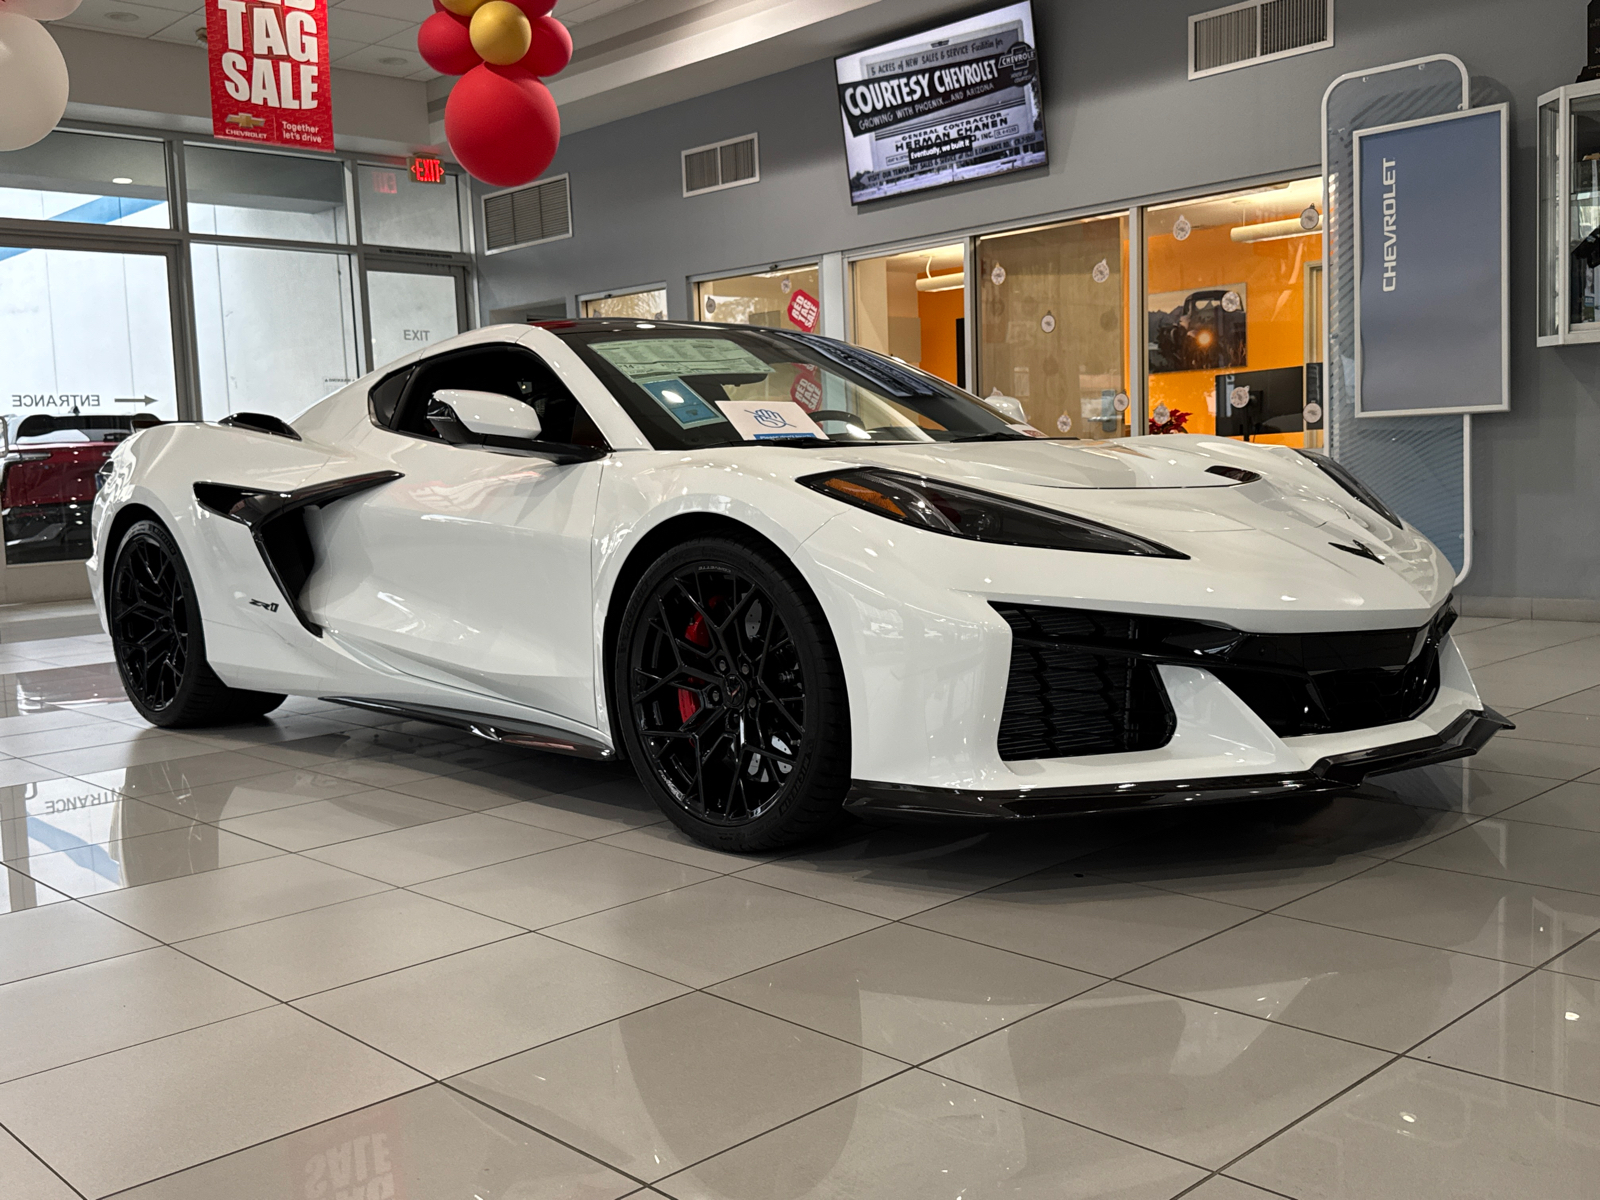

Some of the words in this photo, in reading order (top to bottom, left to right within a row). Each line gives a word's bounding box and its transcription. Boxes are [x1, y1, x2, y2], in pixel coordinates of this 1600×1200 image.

[218, 0, 318, 63] TAG
[878, 62, 895, 74] ACRES
[898, 61, 904, 71] of
[906, 57, 918, 67] NEW
[922, 52, 939, 64] SALES
[946, 45, 968, 58] SERVICE
[222, 51, 318, 110] SALE
[844, 73, 930, 116] COURTESY
[933, 58, 998, 94] CHEVROLET
[858, 111, 893, 130] GROWING
[896, 105, 914, 119] WITH
[966, 82, 994, 97] ARIZONA
[225, 128, 267, 140] CHEVROLET
[282, 121, 319, 133] Together
[283, 130, 300, 140] let's
[301, 132, 322, 143] drive
[895, 131, 951, 152] HERMAN
[956, 117, 1008, 137] CHANEN
[910, 146, 941, 159] Eventually,
[951, 140, 964, 149] built
[415, 158, 440, 182] EXIT
[1382, 157, 1397, 292] CHEVROLET
[791, 294, 805, 321] RED
[798, 299, 812, 324] TAG
[804, 303, 818, 328] SALE
[403, 329, 430, 341] EXIT
[794, 378, 808, 403] RED
[801, 382, 815, 406] TAG
[808, 385, 821, 410] SALE
